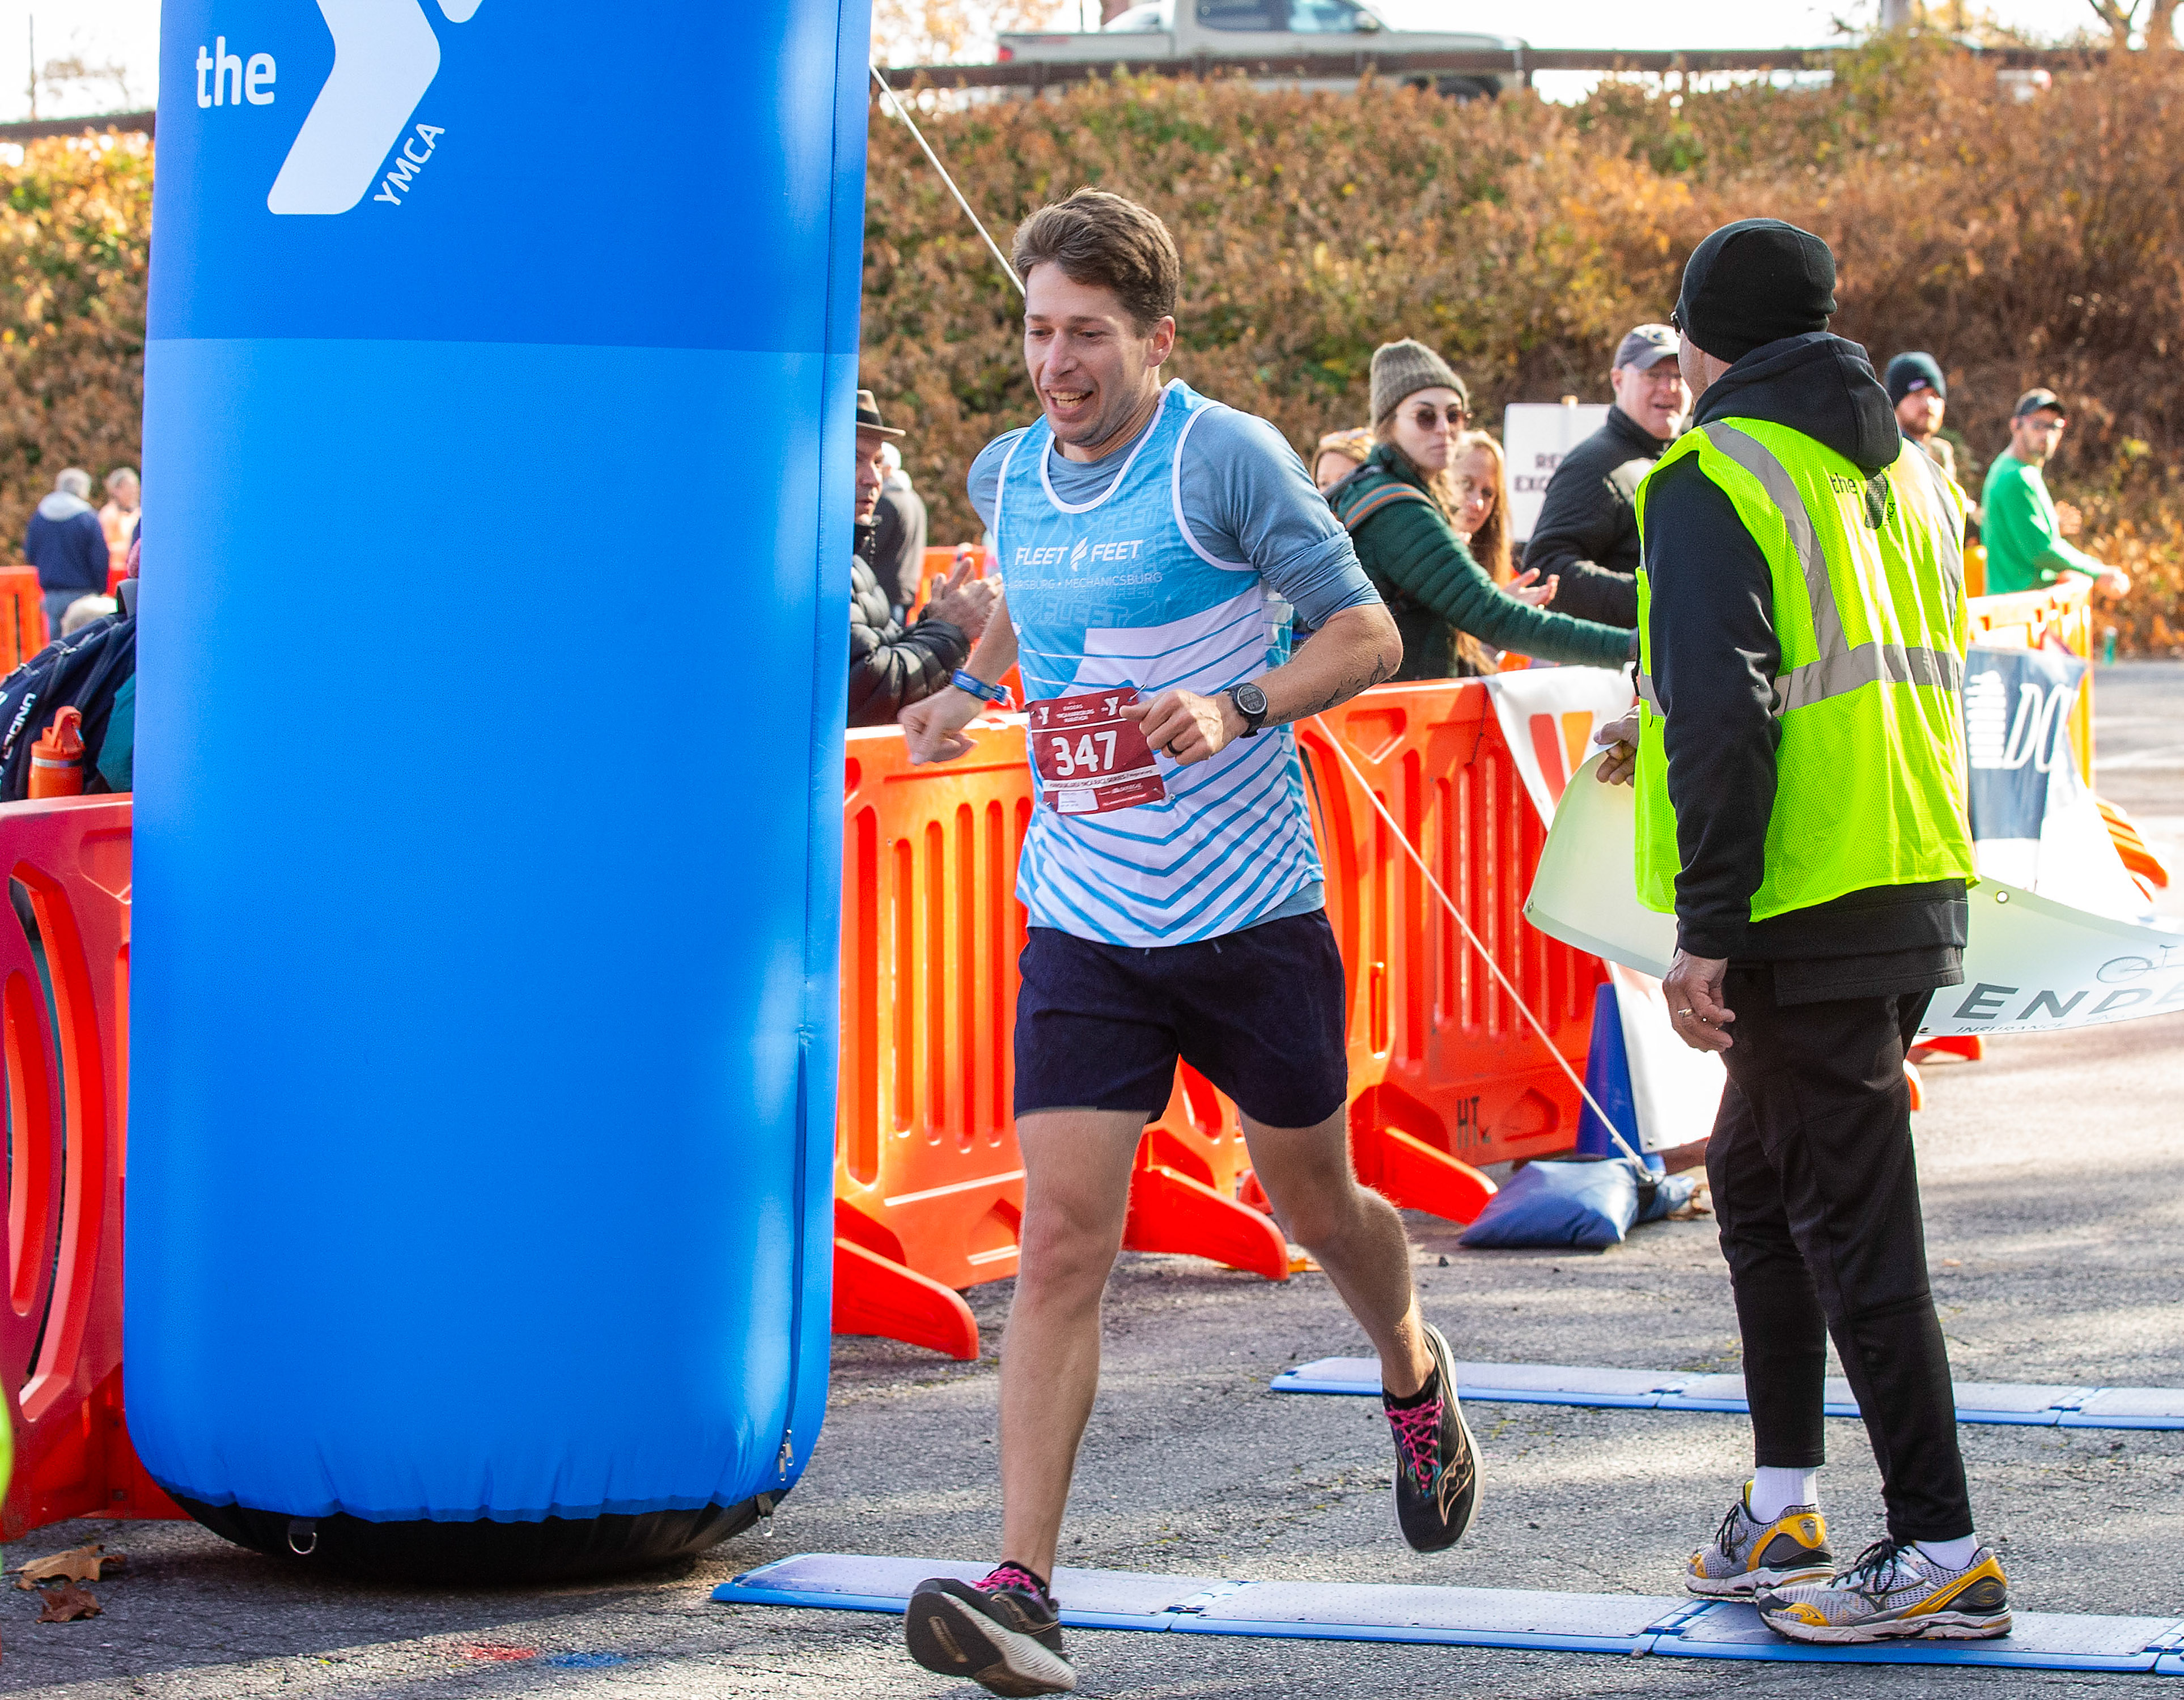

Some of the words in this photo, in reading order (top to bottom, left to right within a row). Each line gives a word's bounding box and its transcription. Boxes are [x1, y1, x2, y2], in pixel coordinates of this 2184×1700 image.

[196, 35, 277, 109] the
[373, 122, 446, 206] YMCA
[1829, 472, 1858, 494] the
[1015, 546, 1068, 566] FLEET
[1091, 539, 1144, 562] FEET
[1065, 572, 1164, 588] MECHANICSBURG
[1051, 730, 1117, 776] 347
